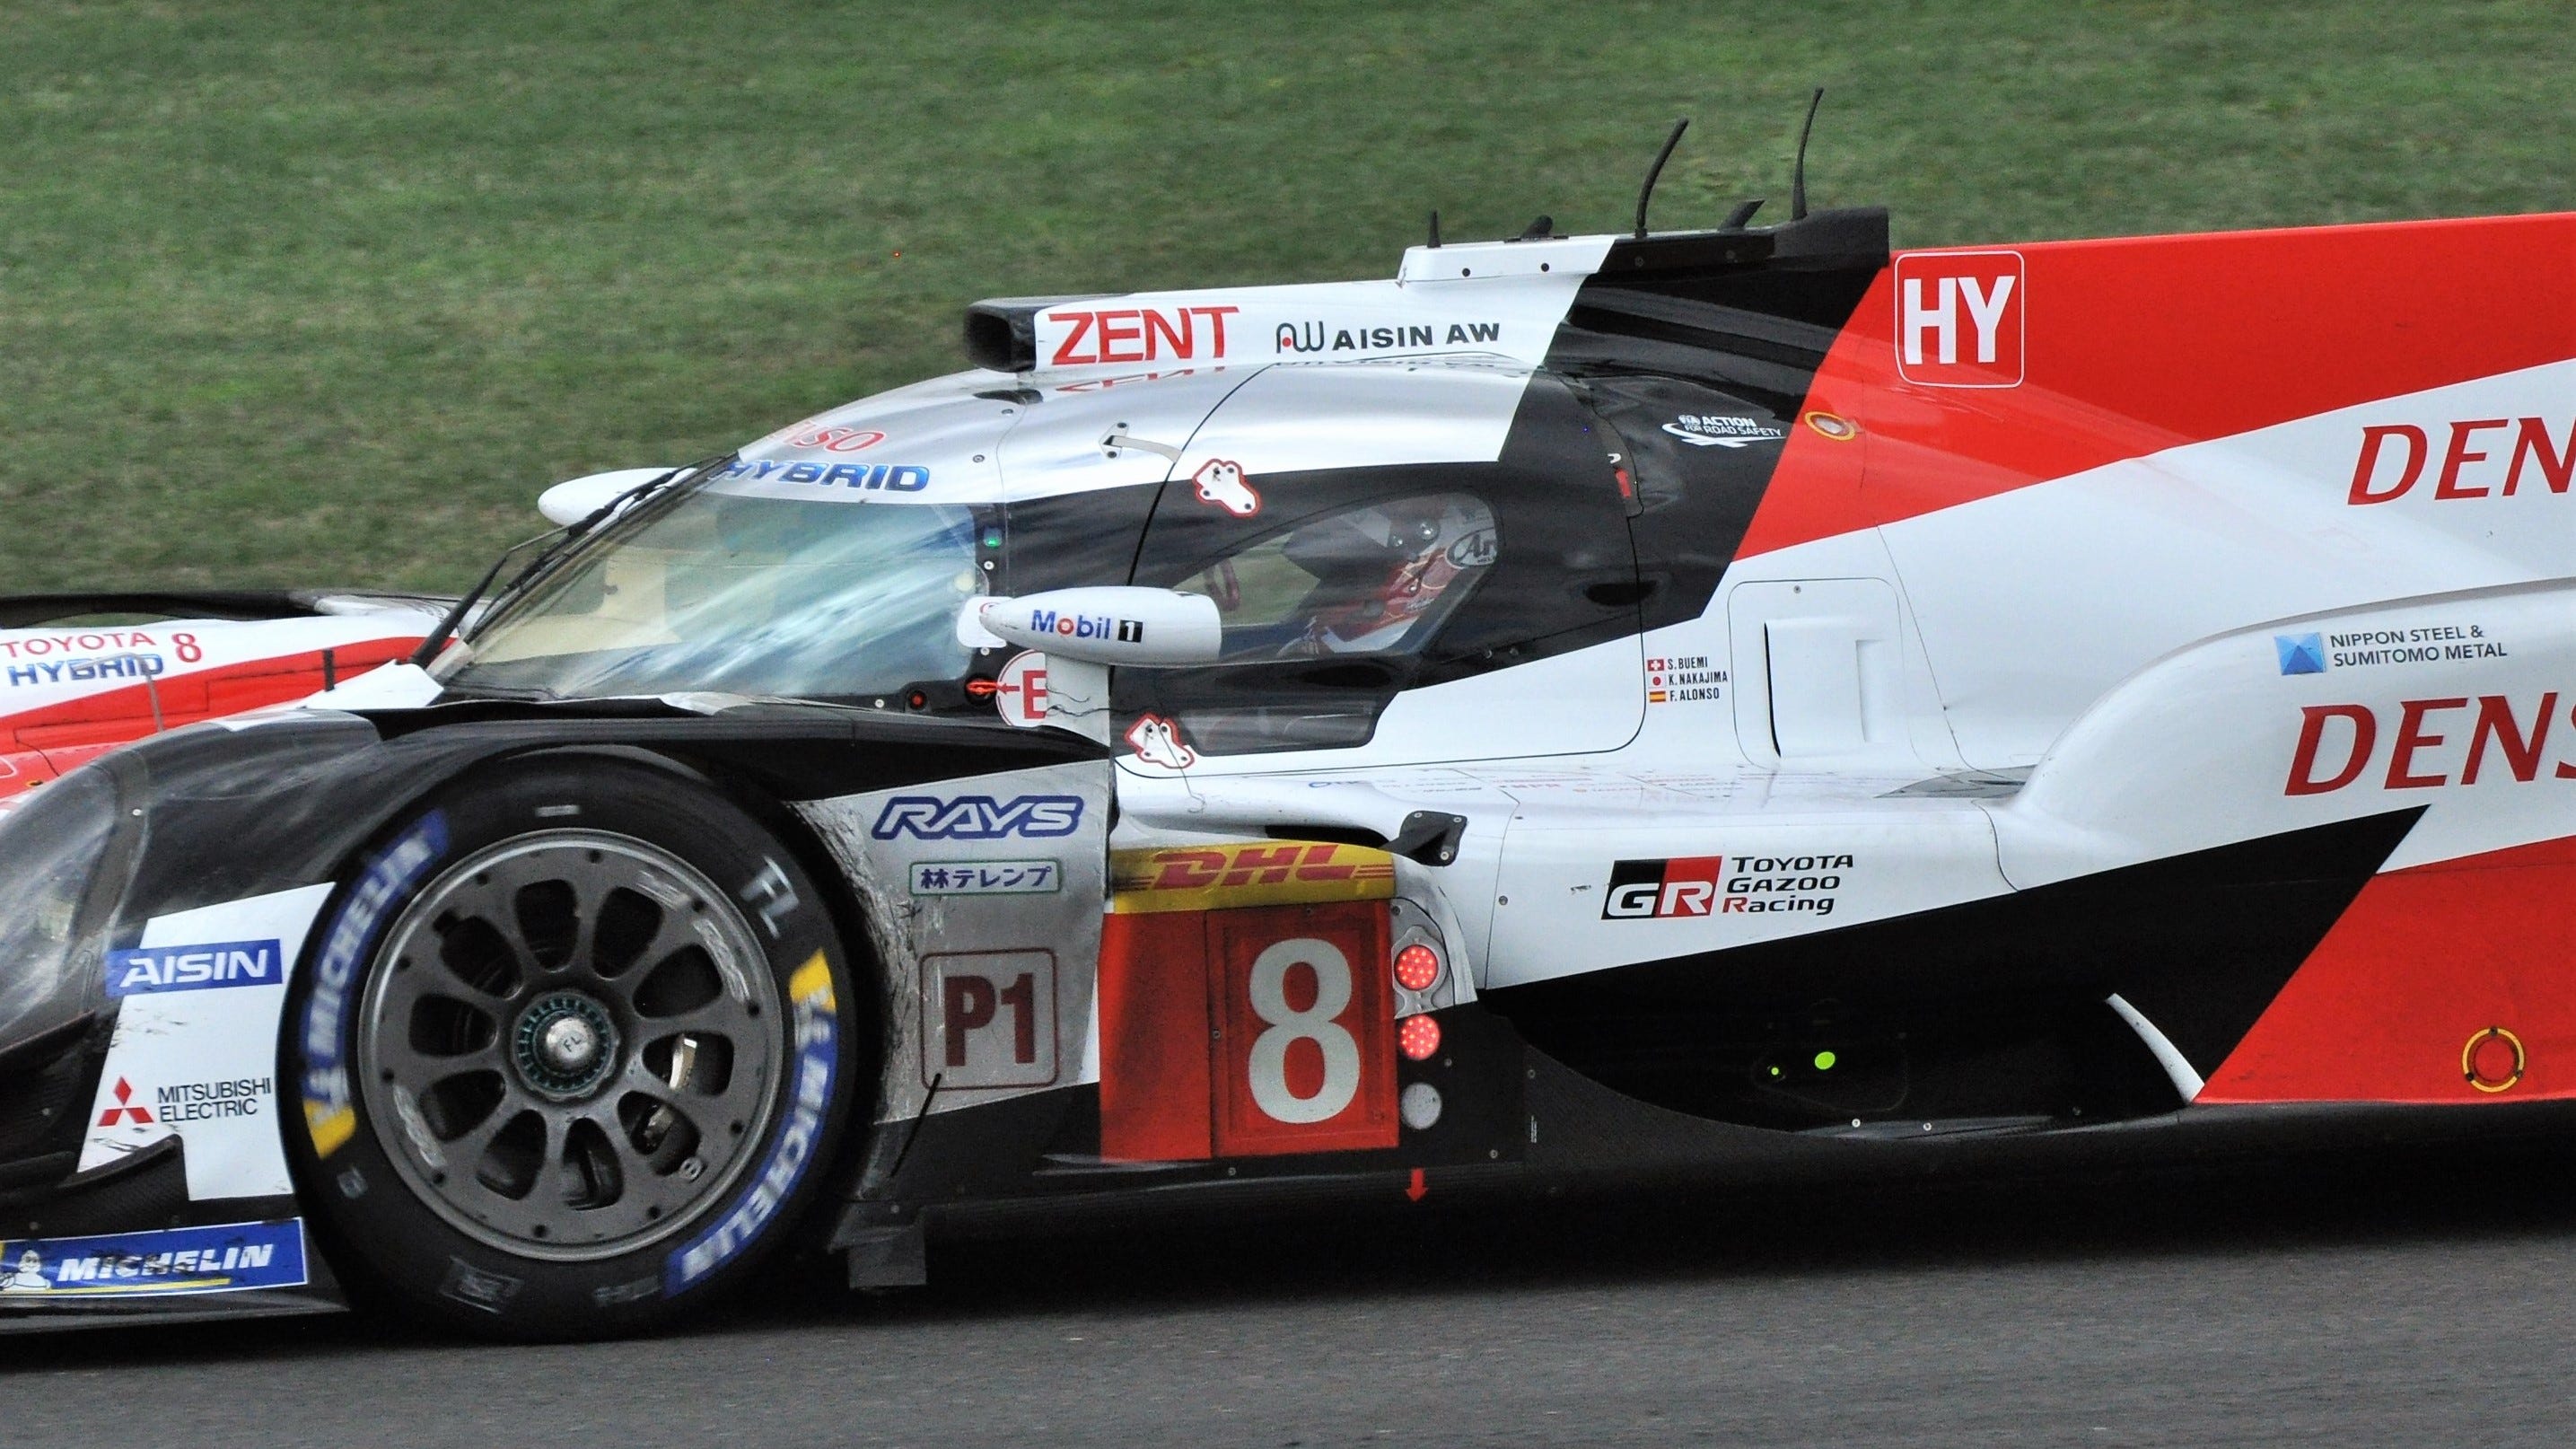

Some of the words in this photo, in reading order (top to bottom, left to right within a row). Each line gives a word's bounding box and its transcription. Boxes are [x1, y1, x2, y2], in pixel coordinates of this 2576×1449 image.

[1047, 305, 1240, 365] ZENT
[1903, 274, 2017, 364] HY
[1332, 325, 1433, 351] AISIN
[1446, 322, 1500, 345] AW
[1702, 416, 1757, 427] ACTION
[1704, 426, 1737, 435] ROAD
[1738, 427, 1782, 437] SAFETY
[721, 458, 930, 493] HYBRID
[1031, 609, 1111, 640] Mobil
[2330, 630, 2405, 648] NIPPON
[2411, 627, 2466, 643] STEEL
[2470, 625, 2484, 638] &
[1, 632, 157, 658] TOYOTA
[171, 633, 202, 663] 8
[2334, 646, 2440, 667] SUMITOMO
[2445, 642, 2507, 660] METAL
[7, 653, 164, 686] HYBRID
[1022, 670, 1047, 719] E
[2284, 692, 2576, 796] DEN
[872, 796, 1084, 841] RAYS
[921, 866, 1052, 890] 林テレンプ
[1152, 844, 1354, 890] DHL
[1732, 855, 1854, 874] TOYOTA
[1607, 881, 1713, 917] GR
[1727, 875, 1841, 894] GAZOO
[1722, 894, 1835, 915] Racing
[119, 949, 267, 988] AISIN
[943, 973, 1037, 1067] P1
[1249, 938, 1361, 1124] 8
[157, 1077, 271, 1103] MITSUBISHI
[160, 1098, 258, 1122] ELECTRIC
[57, 1244, 273, 1282] MICHELIN
